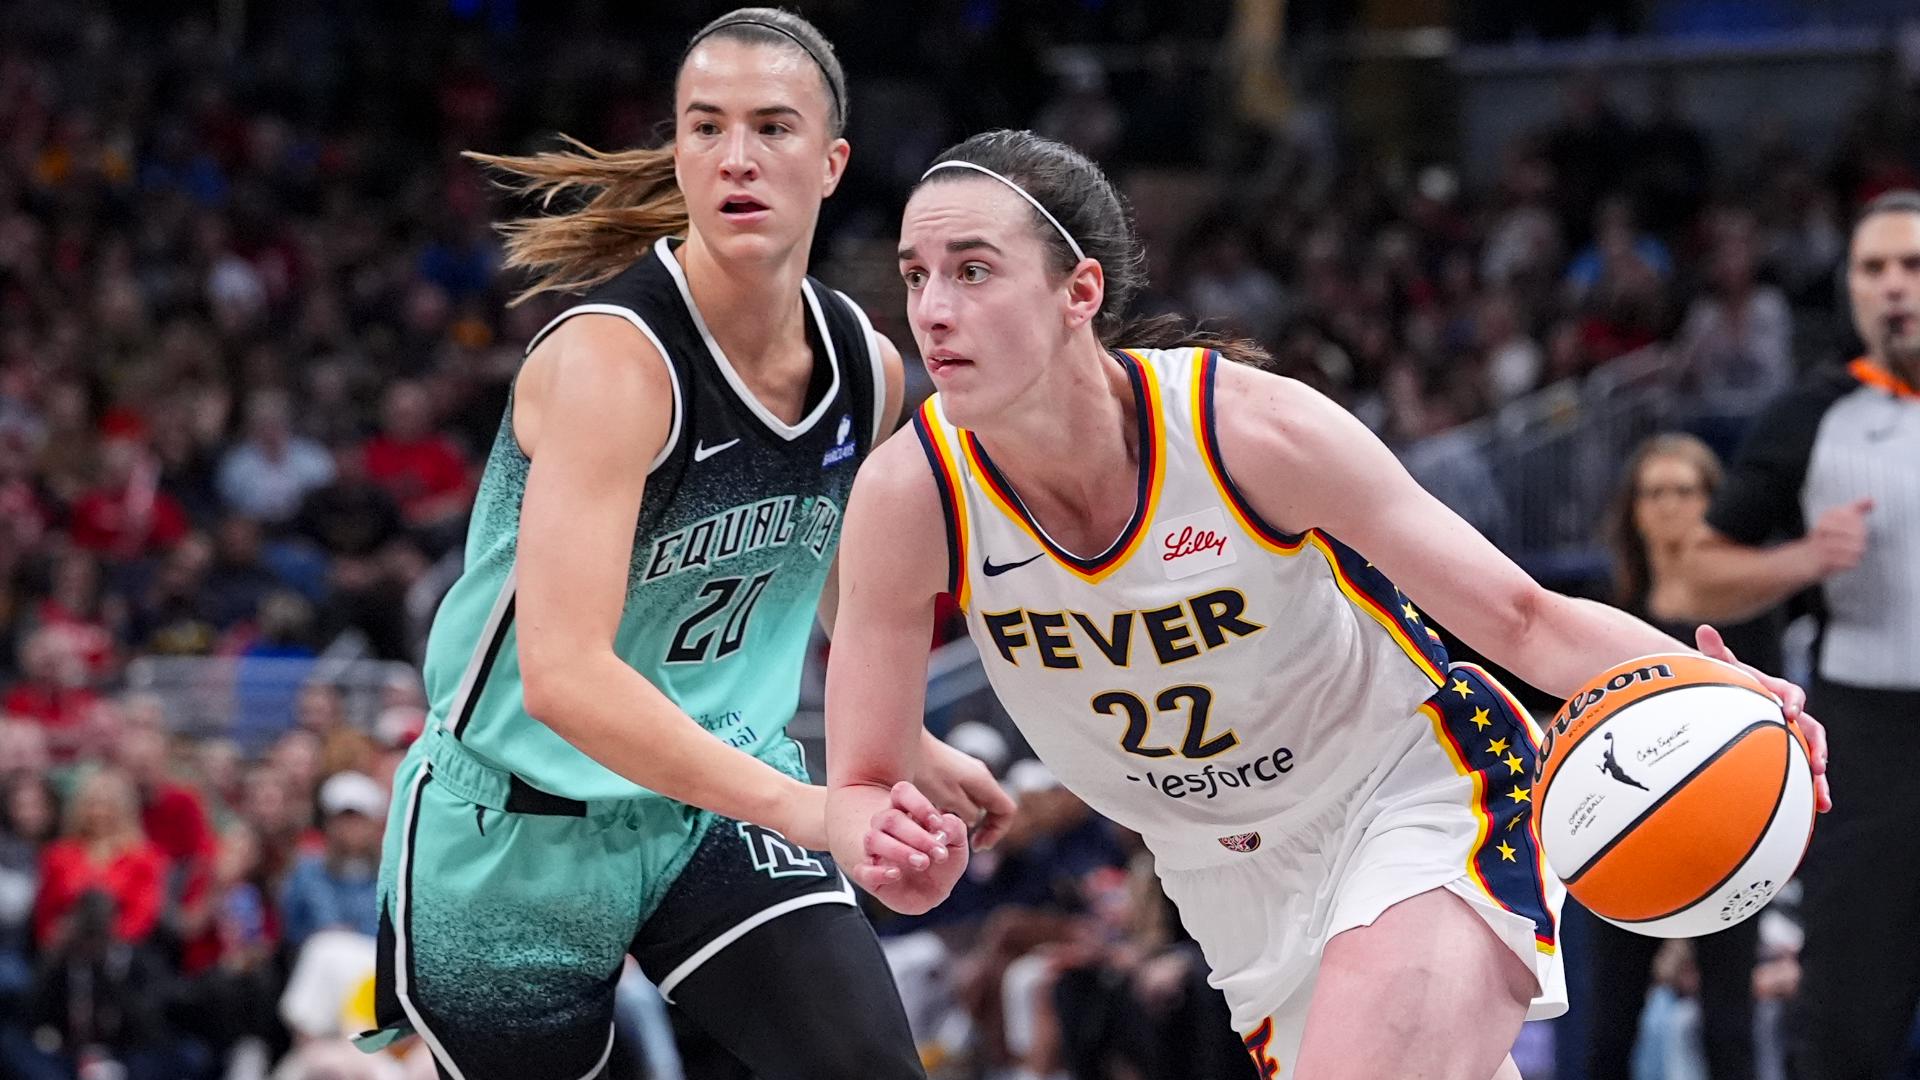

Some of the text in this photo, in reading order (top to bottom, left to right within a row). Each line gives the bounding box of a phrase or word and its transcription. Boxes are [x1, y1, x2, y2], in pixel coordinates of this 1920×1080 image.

[1163, 526, 1228, 562] Lilly
[662, 563, 784, 666] 20
[981, 588, 1267, 669] FEVER
[1090, 683, 1242, 760] 22
